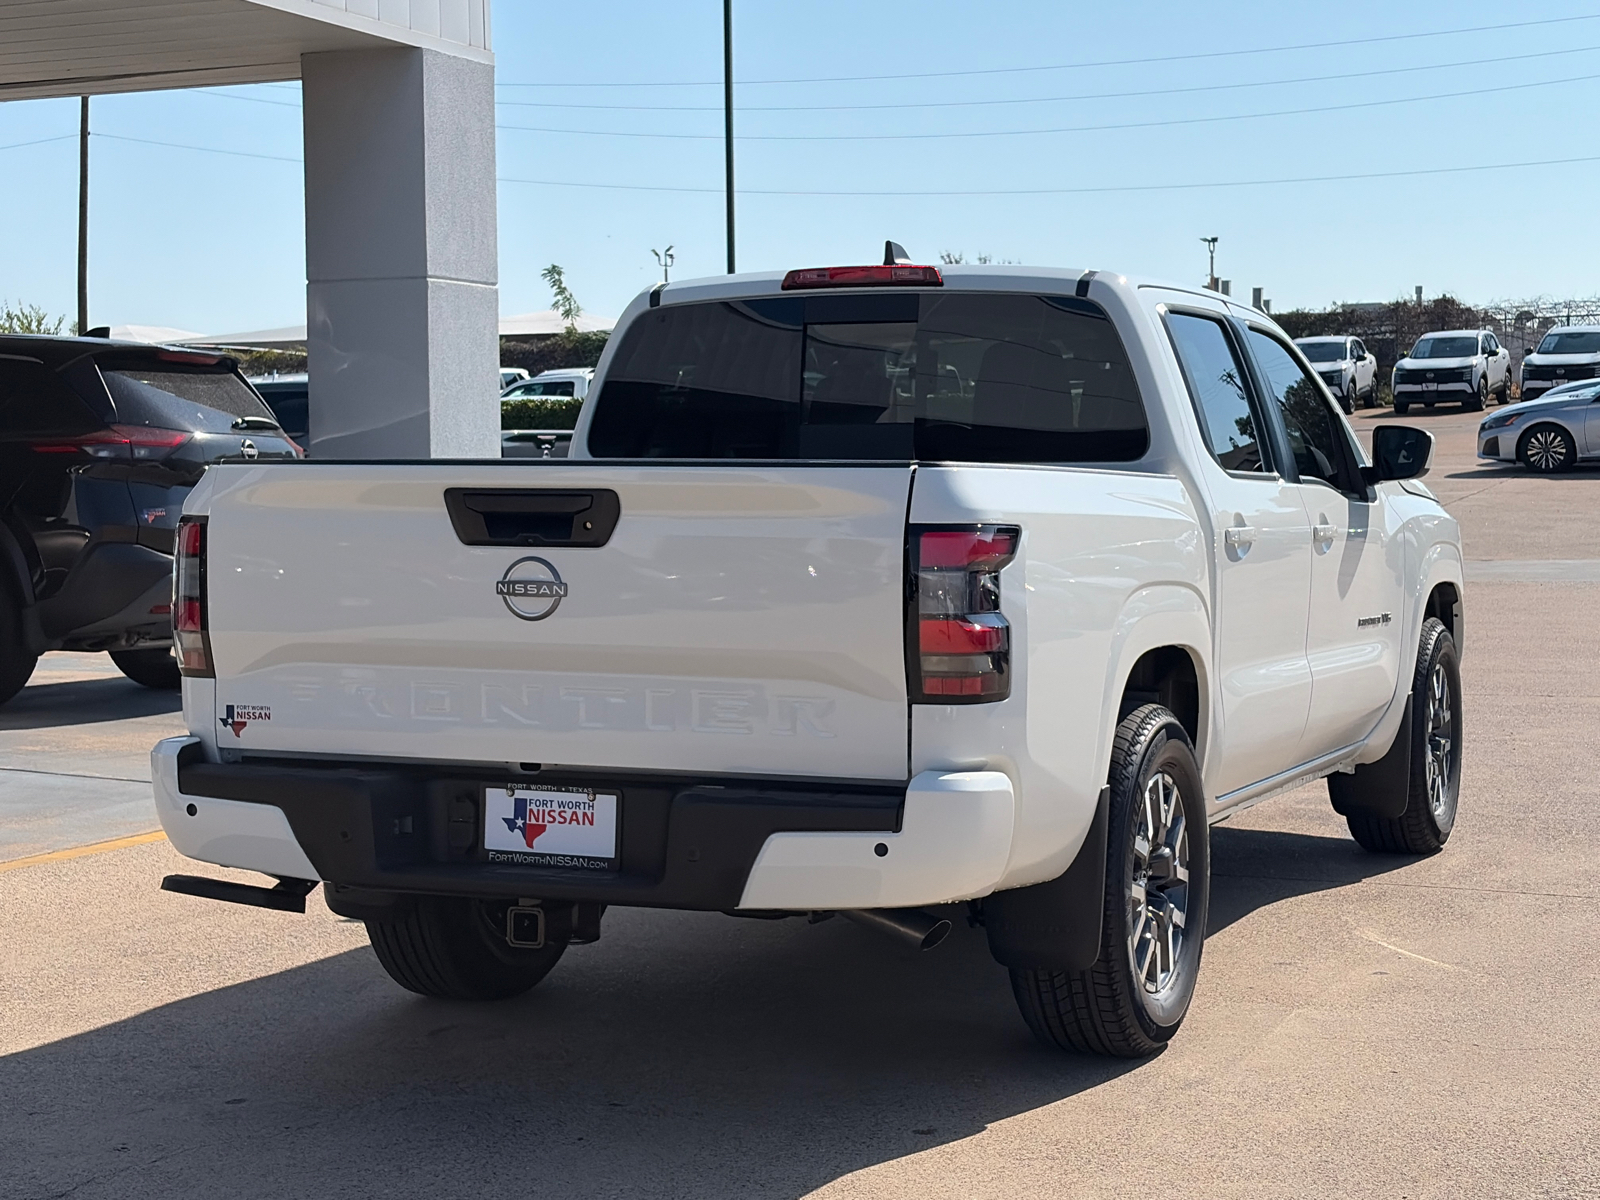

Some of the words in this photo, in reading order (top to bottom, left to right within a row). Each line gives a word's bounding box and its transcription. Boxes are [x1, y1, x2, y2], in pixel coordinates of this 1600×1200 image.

[498, 583, 564, 595] NISSAN
[276, 674, 838, 738] FRONTIER
[236, 711, 271, 720] NISSAN
[530, 784, 557, 792] WORTH
[568, 786, 593, 794] TEXAS
[528, 799, 554, 809] FORT
[557, 800, 595, 811] WORTH
[528, 808, 594, 826] NISSAN
